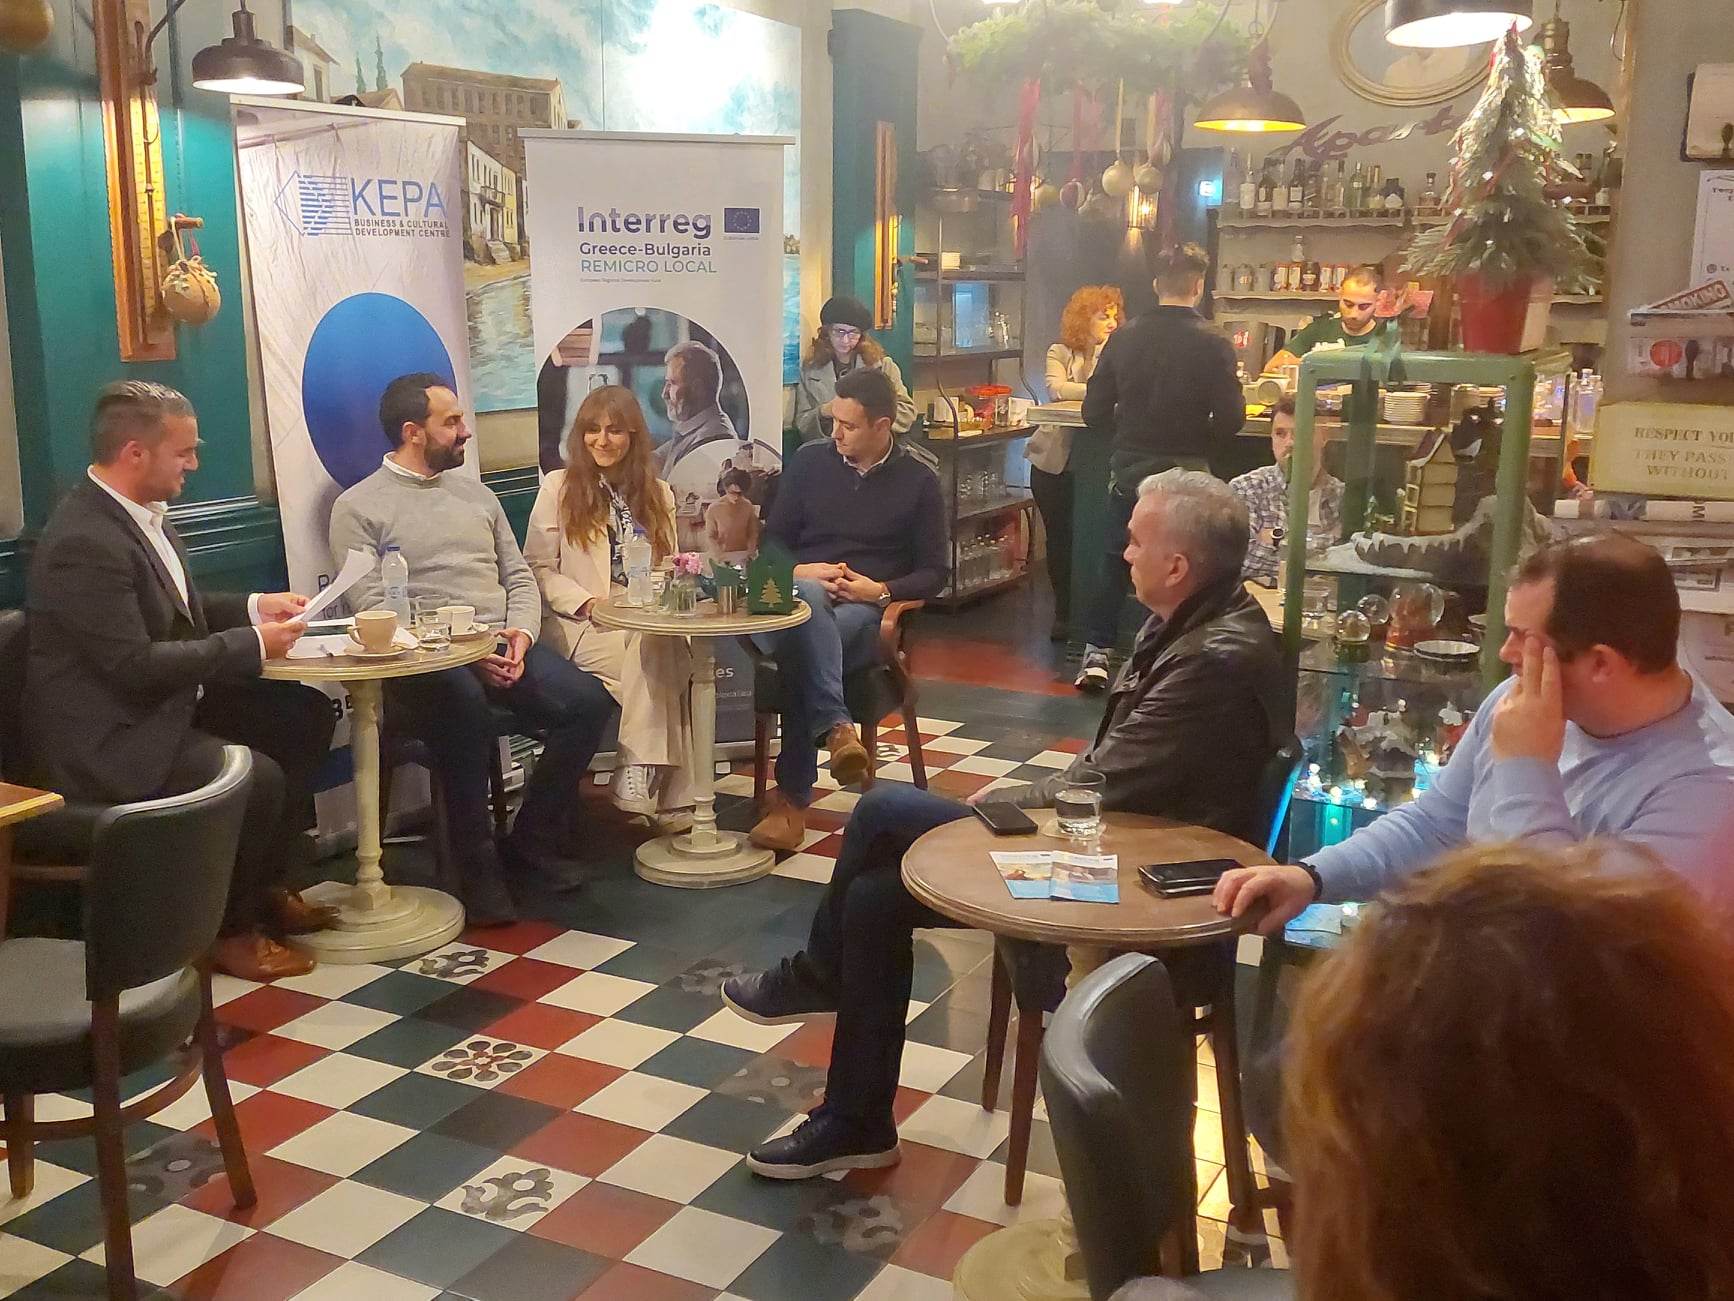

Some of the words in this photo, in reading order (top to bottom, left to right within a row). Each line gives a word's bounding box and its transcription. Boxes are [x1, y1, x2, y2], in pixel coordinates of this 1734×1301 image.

[350, 177, 448, 218] KEPA
[354, 218, 398, 228] BUSINESS
[399, 219, 404, 228] &
[406, 220, 449, 229] CULTURAL
[577, 206, 712, 240] Interreg
[355, 228, 417, 237] DEVELOPMENT
[418, 229, 451, 238] CENTRE
[579, 242, 711, 258] Greece-Bulgaria
[581, 259, 659, 273] REMICRO
[664, 260, 717, 273] LOCAL
[1634, 427, 1702, 441] RESPECT
[1685, 451, 1727, 463] PASS
